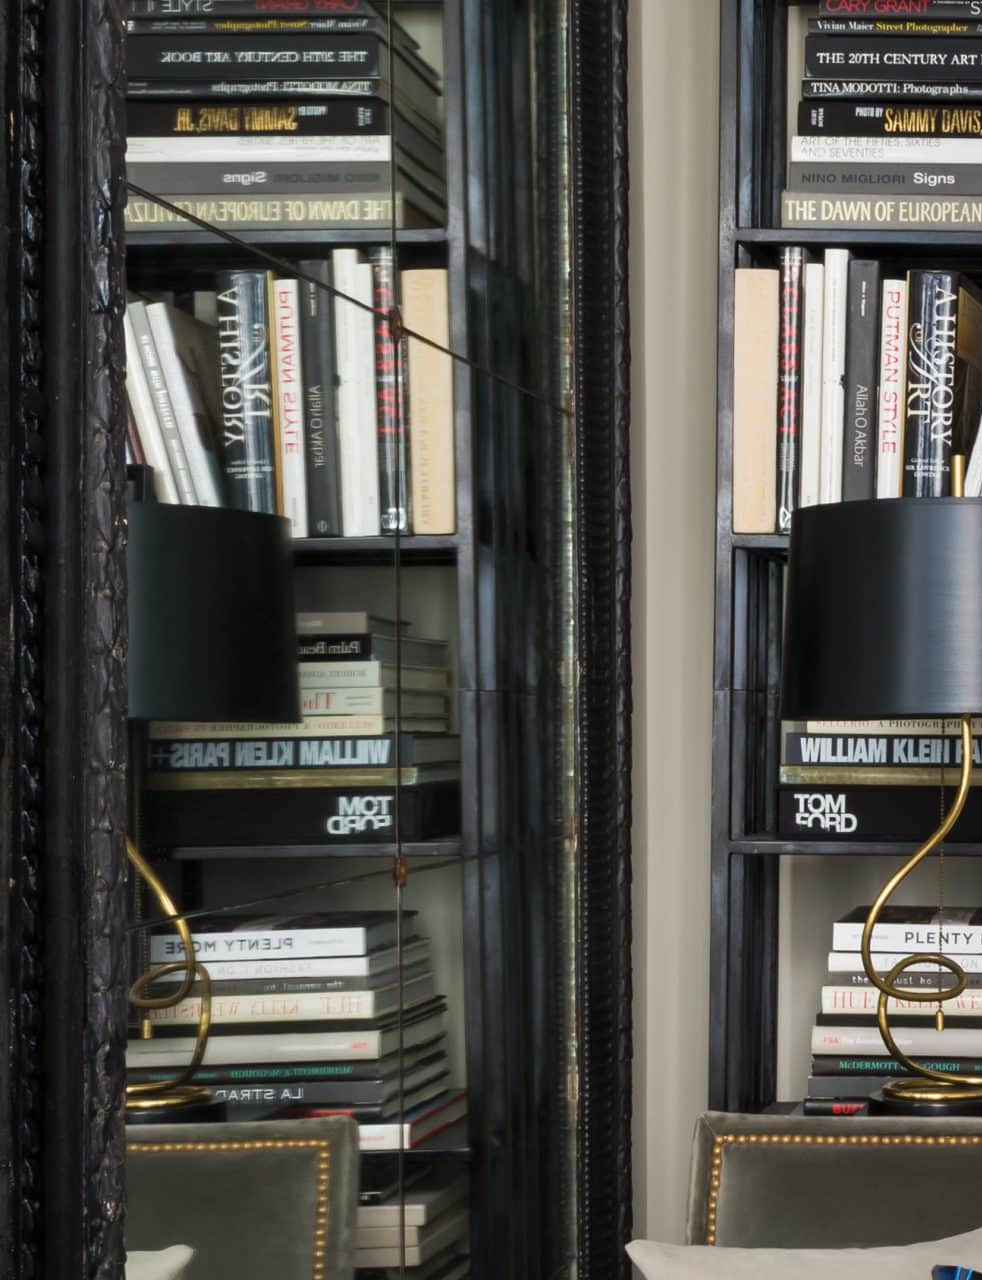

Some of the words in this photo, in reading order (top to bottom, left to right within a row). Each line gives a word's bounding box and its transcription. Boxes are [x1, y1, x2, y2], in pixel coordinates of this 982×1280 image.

[825, 0, 869, 13] CARY
[874, 0, 930, 13] GRANT
[817, 21, 846, 31] Vivian
[849, 21, 874, 31] Maier
[876, 22, 903, 32] Street
[906, 22, 969, 34] Photographer
[816, 52, 845, 64] THE
[848, 53, 880, 64] 20TH
[883, 53, 947, 65] CENTURY
[951, 54, 978, 65] ART
[811, 82, 839, 93] TINA
[903, 83, 969, 97] Photographs
[884, 108, 938, 133] SAMMY
[801, 173, 837, 184] NINO
[913, 172, 956, 187] Signs
[786, 200, 816, 220] THE
[821, 201, 871, 221] DAWN
[875, 202, 895, 221] OF
[899, 202, 982, 222] EUROPEAN
[935, 287, 958, 305] A
[780, 287, 799, 372] CLASS
[884, 290, 901, 383] PUTMAN
[931, 310, 957, 447] HISTORY
[856, 385, 869, 415] Allah
[779, 387, 798, 437] ACT
[882, 392, 897, 453] STYLE
[854, 432, 869, 467] Akbar
[801, 737, 887, 763] WILLIAM
[893, 738, 949, 763] KLEIN
[794, 794, 846, 813] TOM
[795, 813, 857, 832] FORD
[905, 932, 973, 944] PLENTY
[839, 1061, 897, 1070] McDERMOTT
